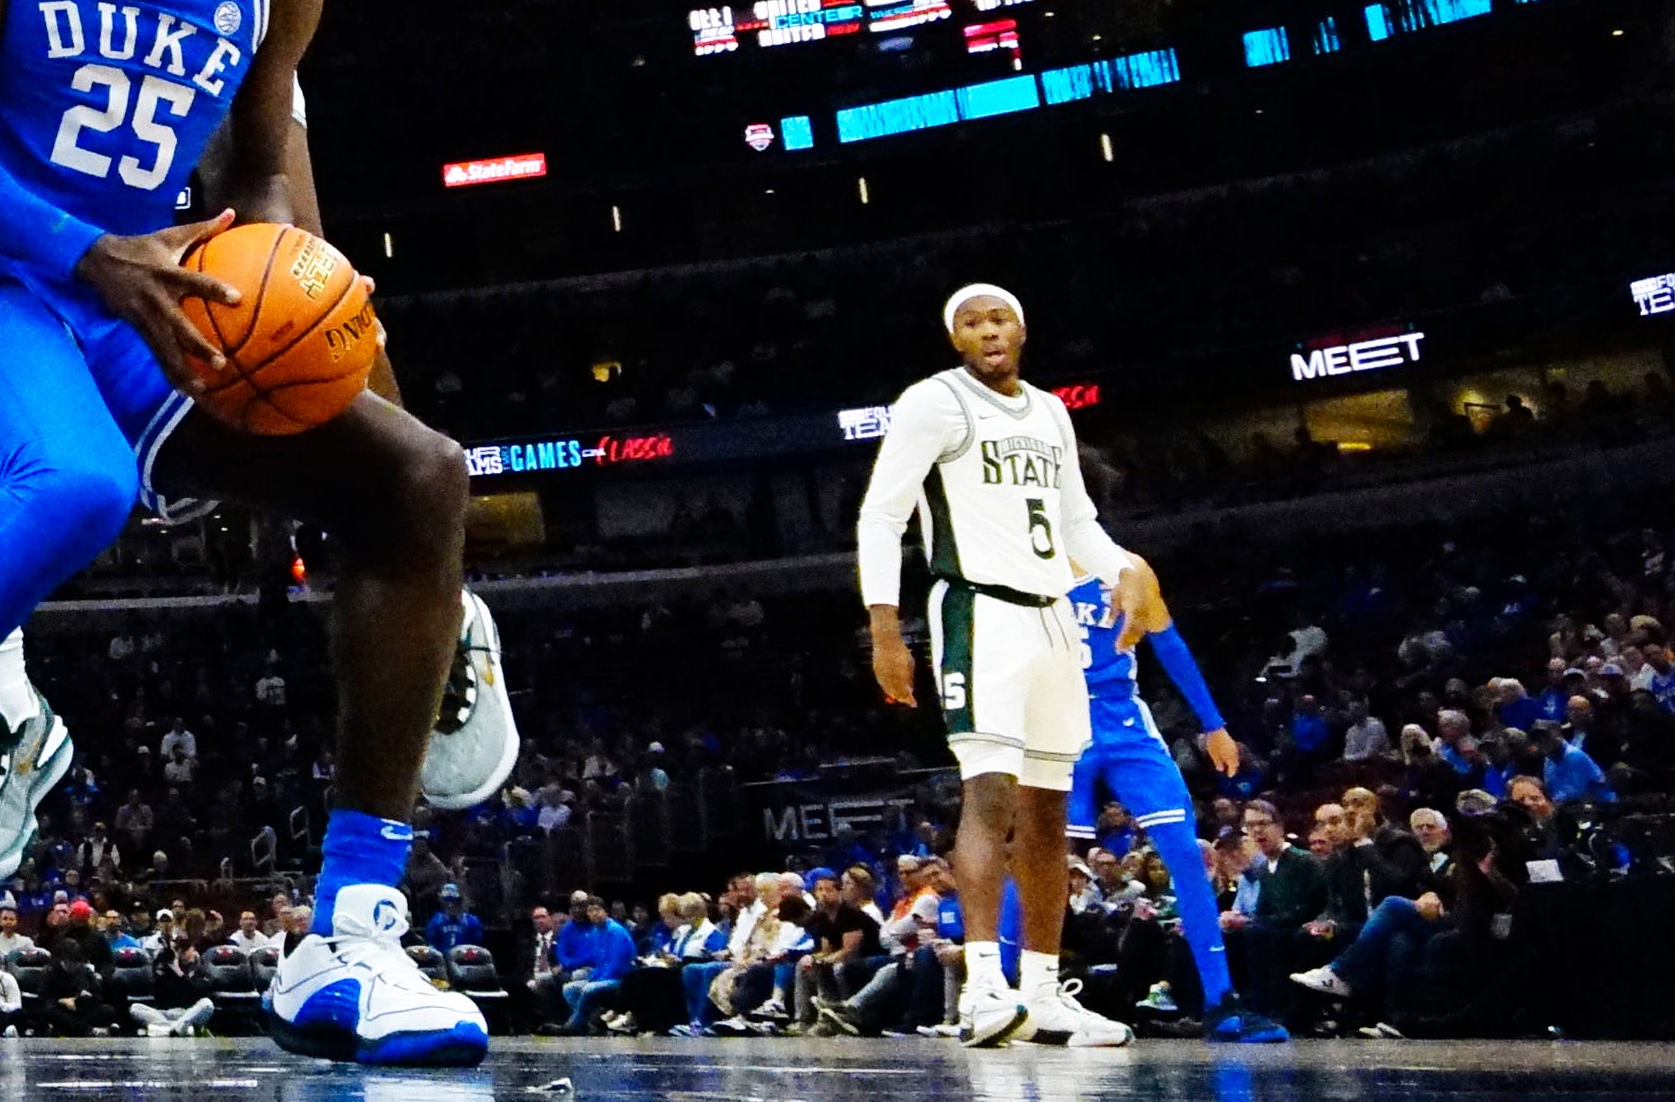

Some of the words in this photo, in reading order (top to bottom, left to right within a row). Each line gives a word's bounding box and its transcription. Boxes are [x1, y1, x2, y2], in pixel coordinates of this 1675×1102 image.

[39, 0, 241, 96] DUKE
[50, 63, 195, 190] 25
[1290, 332, 1424, 380] MEET
[511, 440, 582, 472] GAMES
[982, 441, 1062, 489] STATE
[1026, 498, 1056, 560] 5
